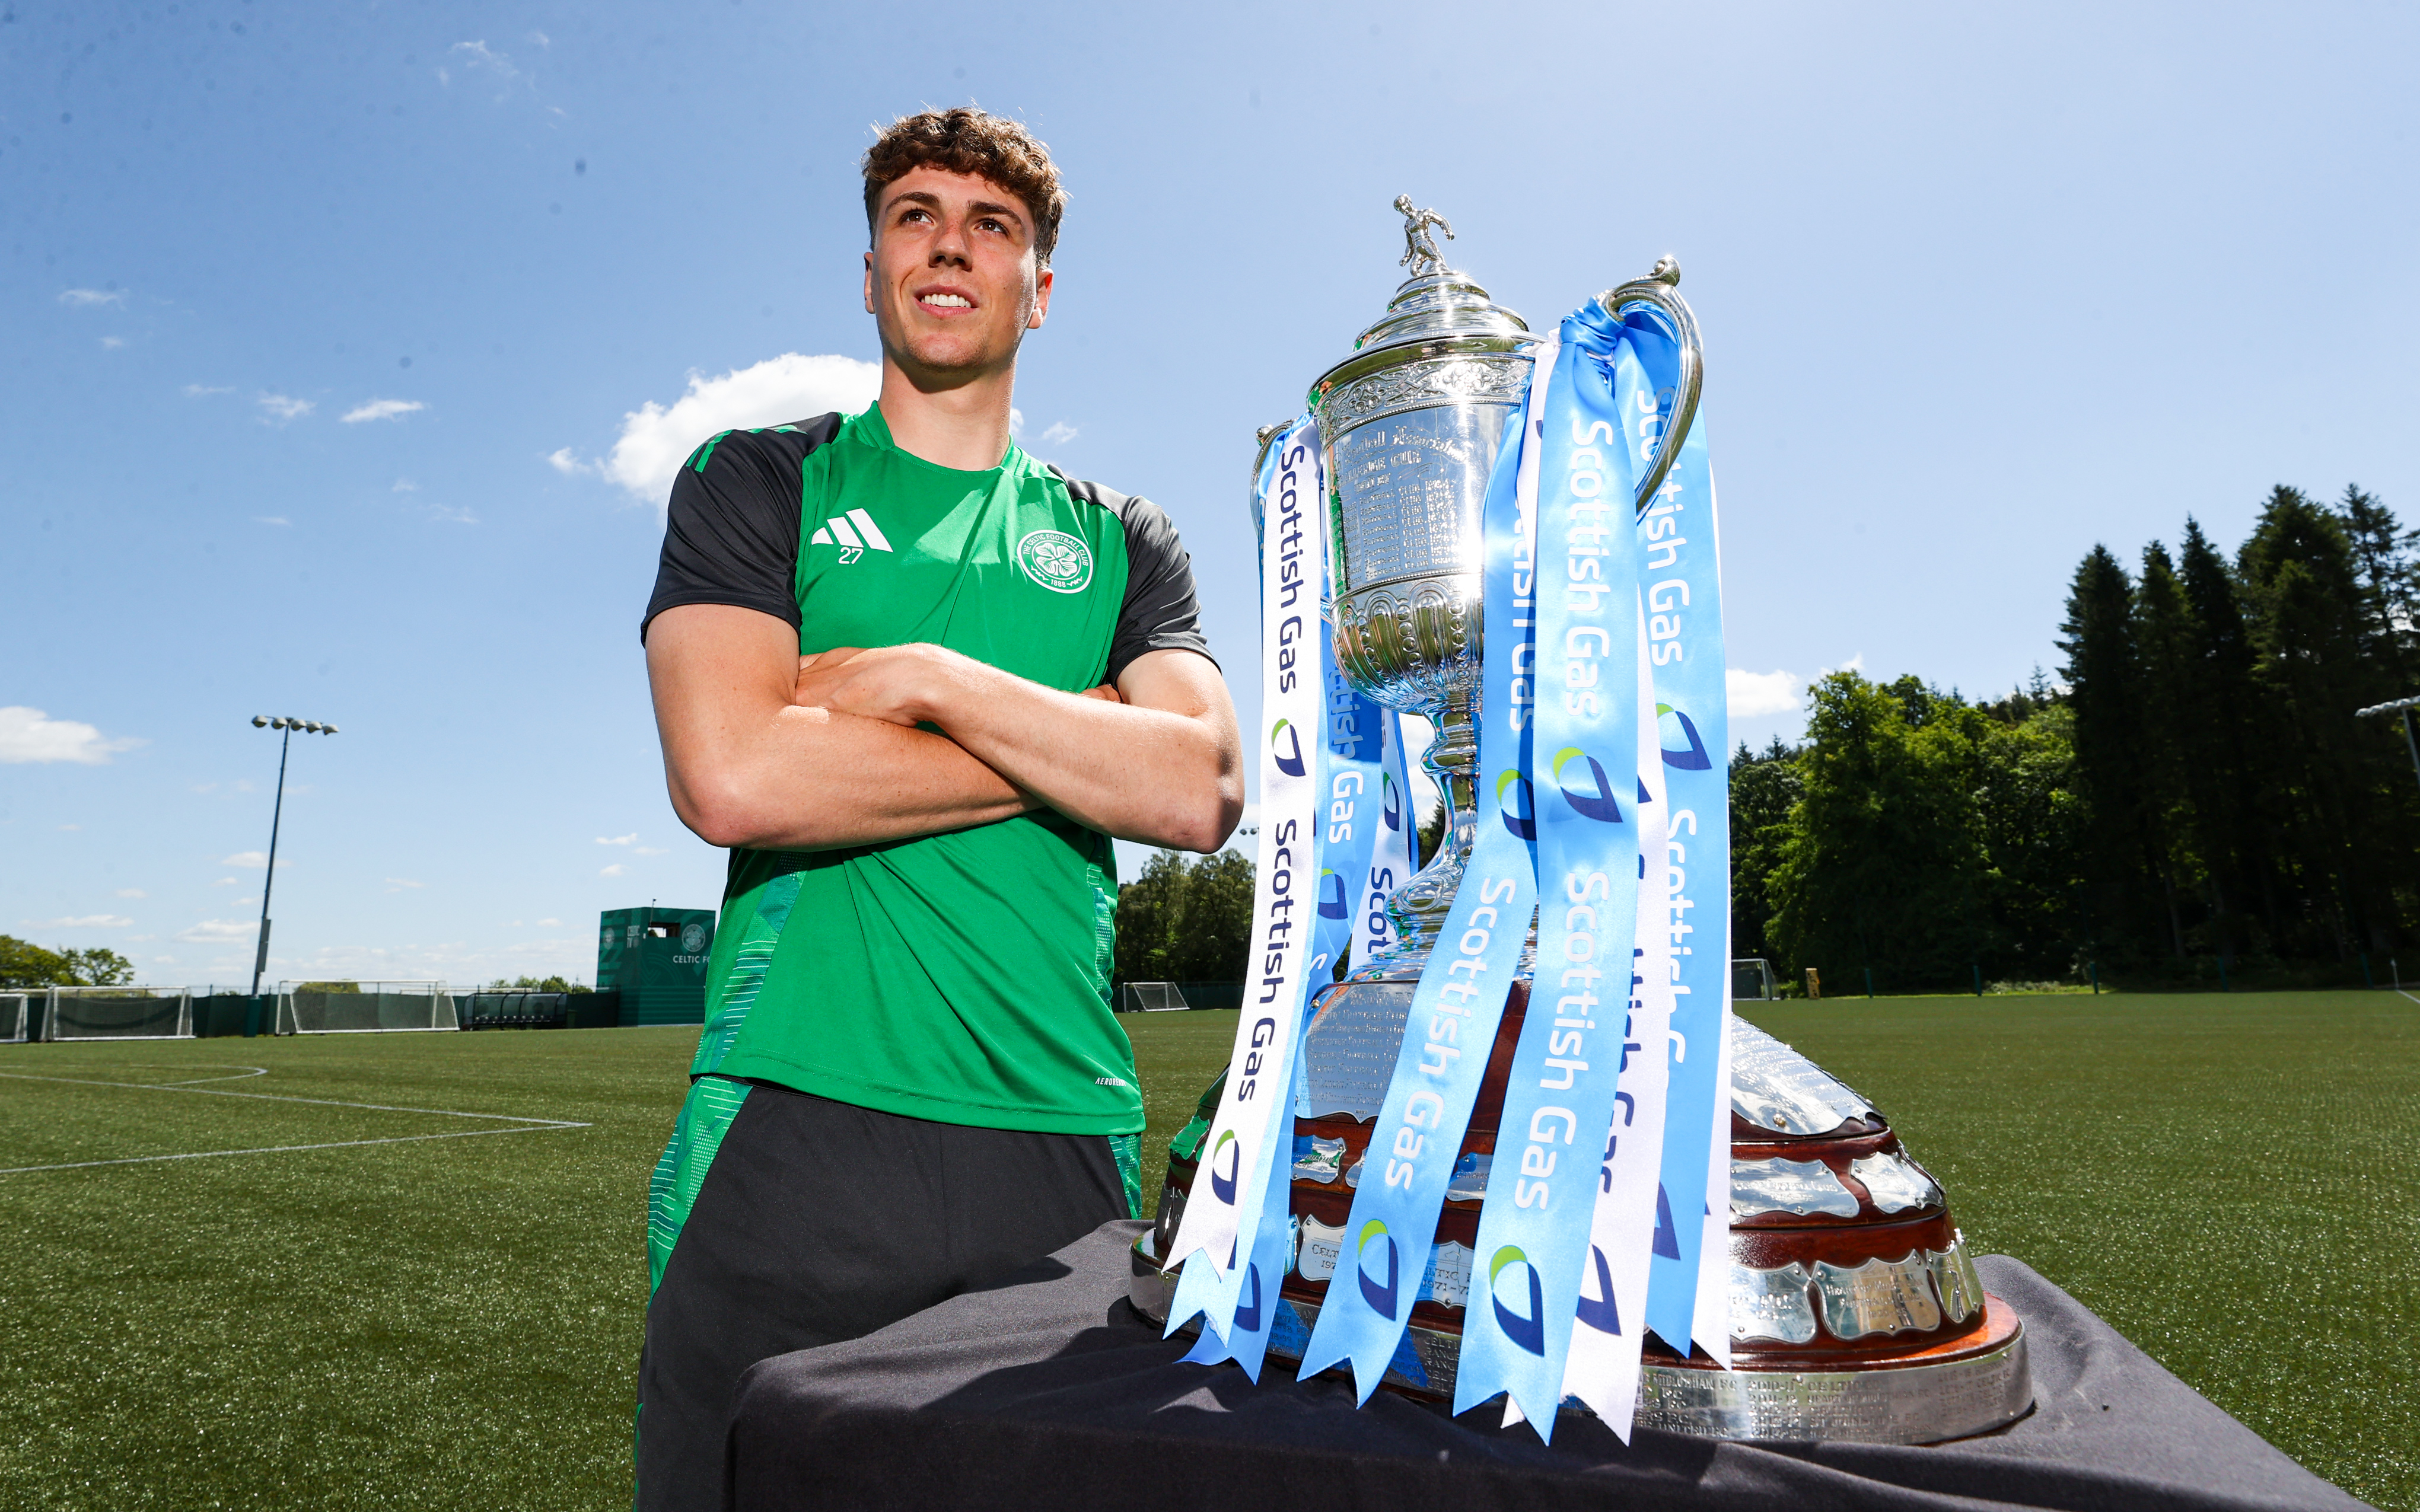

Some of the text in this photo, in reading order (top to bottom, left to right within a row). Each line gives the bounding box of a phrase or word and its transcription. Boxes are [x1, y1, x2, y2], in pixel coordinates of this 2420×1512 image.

[1637, 386, 1690, 666] Scotish Gas
[838, 547, 864, 564] 27
[1023, 534, 1089, 566] THE CELTIC FOOTBALL CLUB
[1279, 445, 1305, 694] Scottish Gas
[1565, 420, 1613, 716] Scottish Gas
[1050, 579, 1066, 588] 1888
[1329, 652, 1364, 844] ttish Gas
[1368, 867, 1393, 953] Scot
[673, 955, 700, 964] CELTIC
[1238, 819, 1297, 1102] Scottish Gas
[1385, 878, 1516, 1189] Scottish Gas
[1515, 872, 1609, 1210] Scottish Gas
[1311, 1244, 1339, 1258] CELT
[1321, 1260, 1336, 1269] 197
[1425, 1267, 1459, 1281] LTIC
[1423, 1279, 1469, 1295] 1971-7
[1424, 1336, 1458, 1350] CELTI
[1424, 1347, 1460, 1361] RANGE
[1425, 1357, 1457, 1371] RANG
[1425, 1369, 1456, 1383] CELT
[1426, 1380, 1456, 1394] CELT
